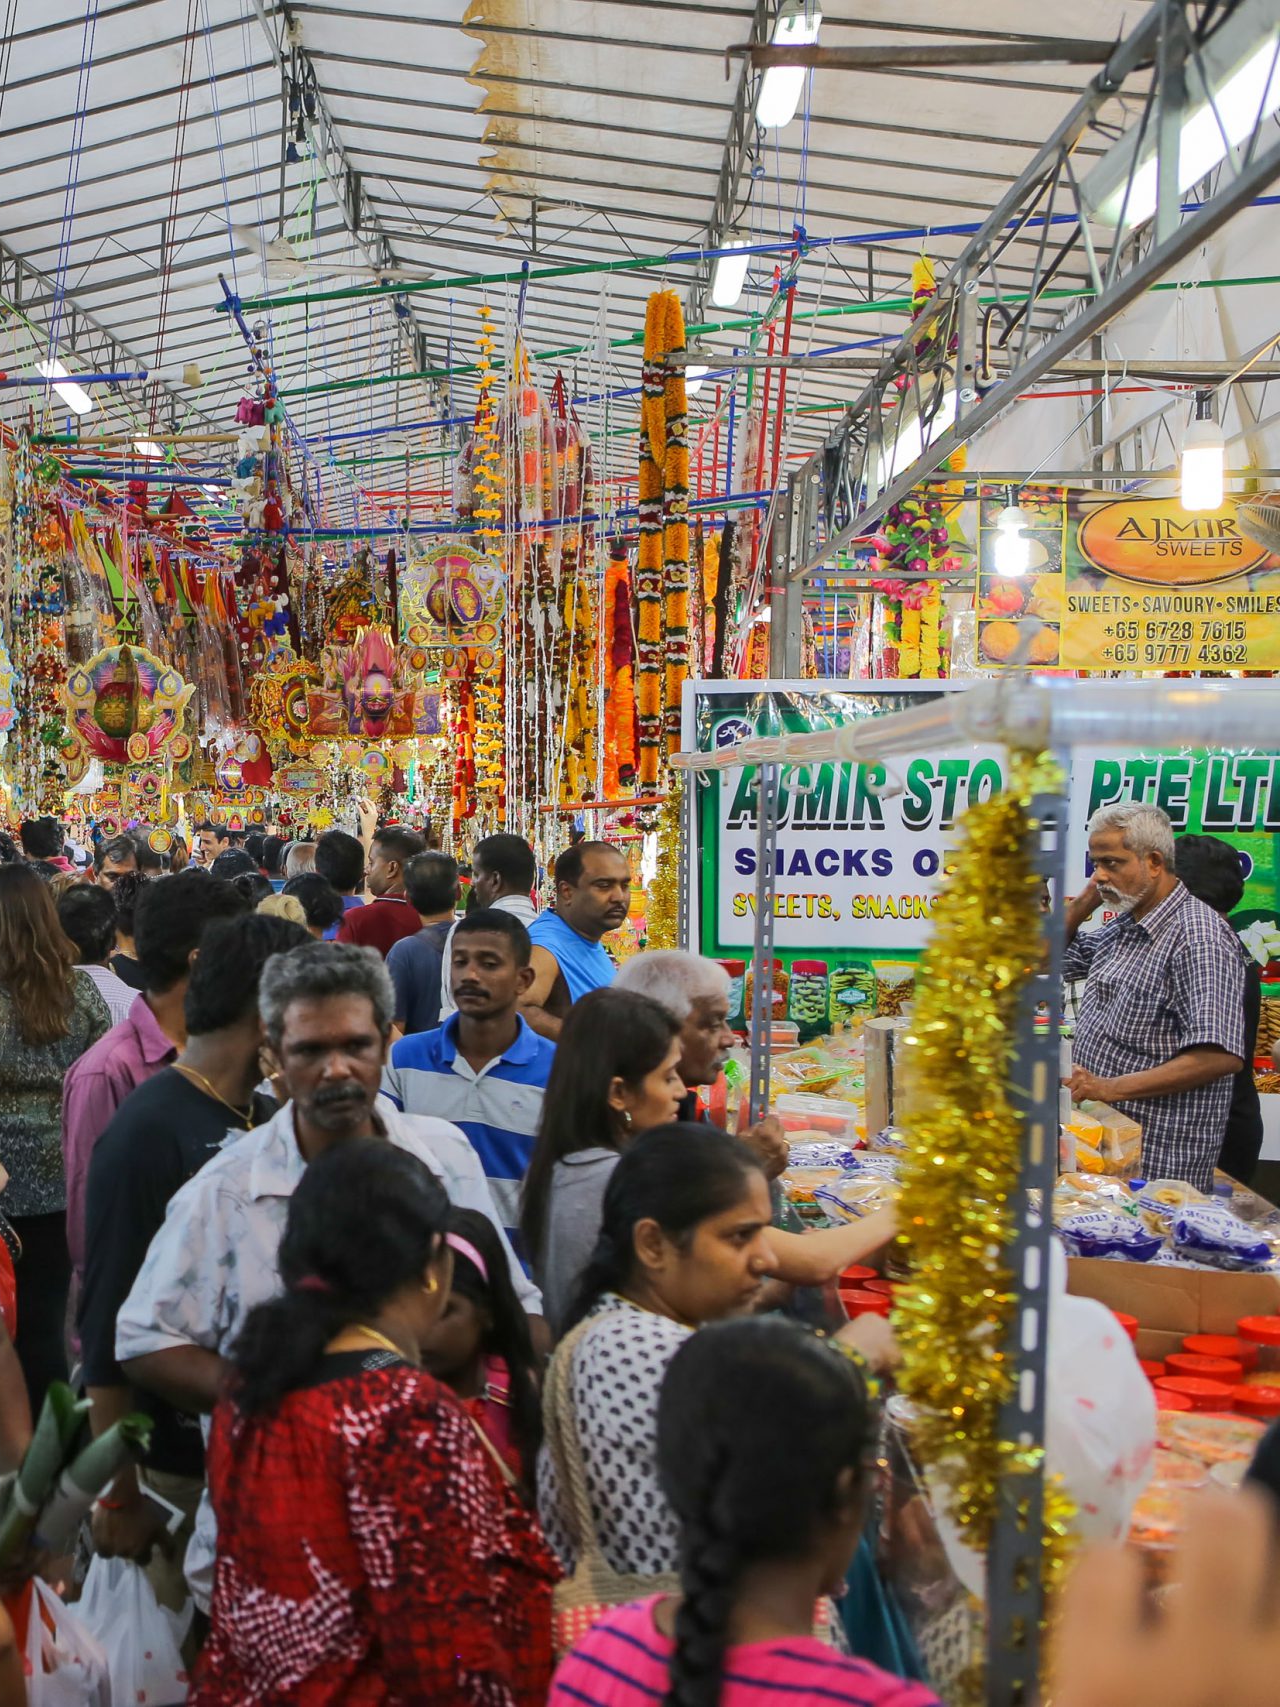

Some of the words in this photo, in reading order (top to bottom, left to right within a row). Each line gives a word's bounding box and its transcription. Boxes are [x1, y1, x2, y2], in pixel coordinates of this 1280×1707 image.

[1115, 517, 1242, 545] AJMIR
[1155, 541, 1243, 557] SWEETS
[1068, 596, 1131, 613] SWEETS
[1142, 596, 1215, 613] SAVOURY
[1104, 621, 1139, 640] +65
[1145, 621, 1192, 640] 6728
[1201, 621, 1246, 640] 7615
[1102, 644, 1138, 663] +65
[1144, 644, 1190, 663] 9777
[1198, 644, 1247, 663] 4362
